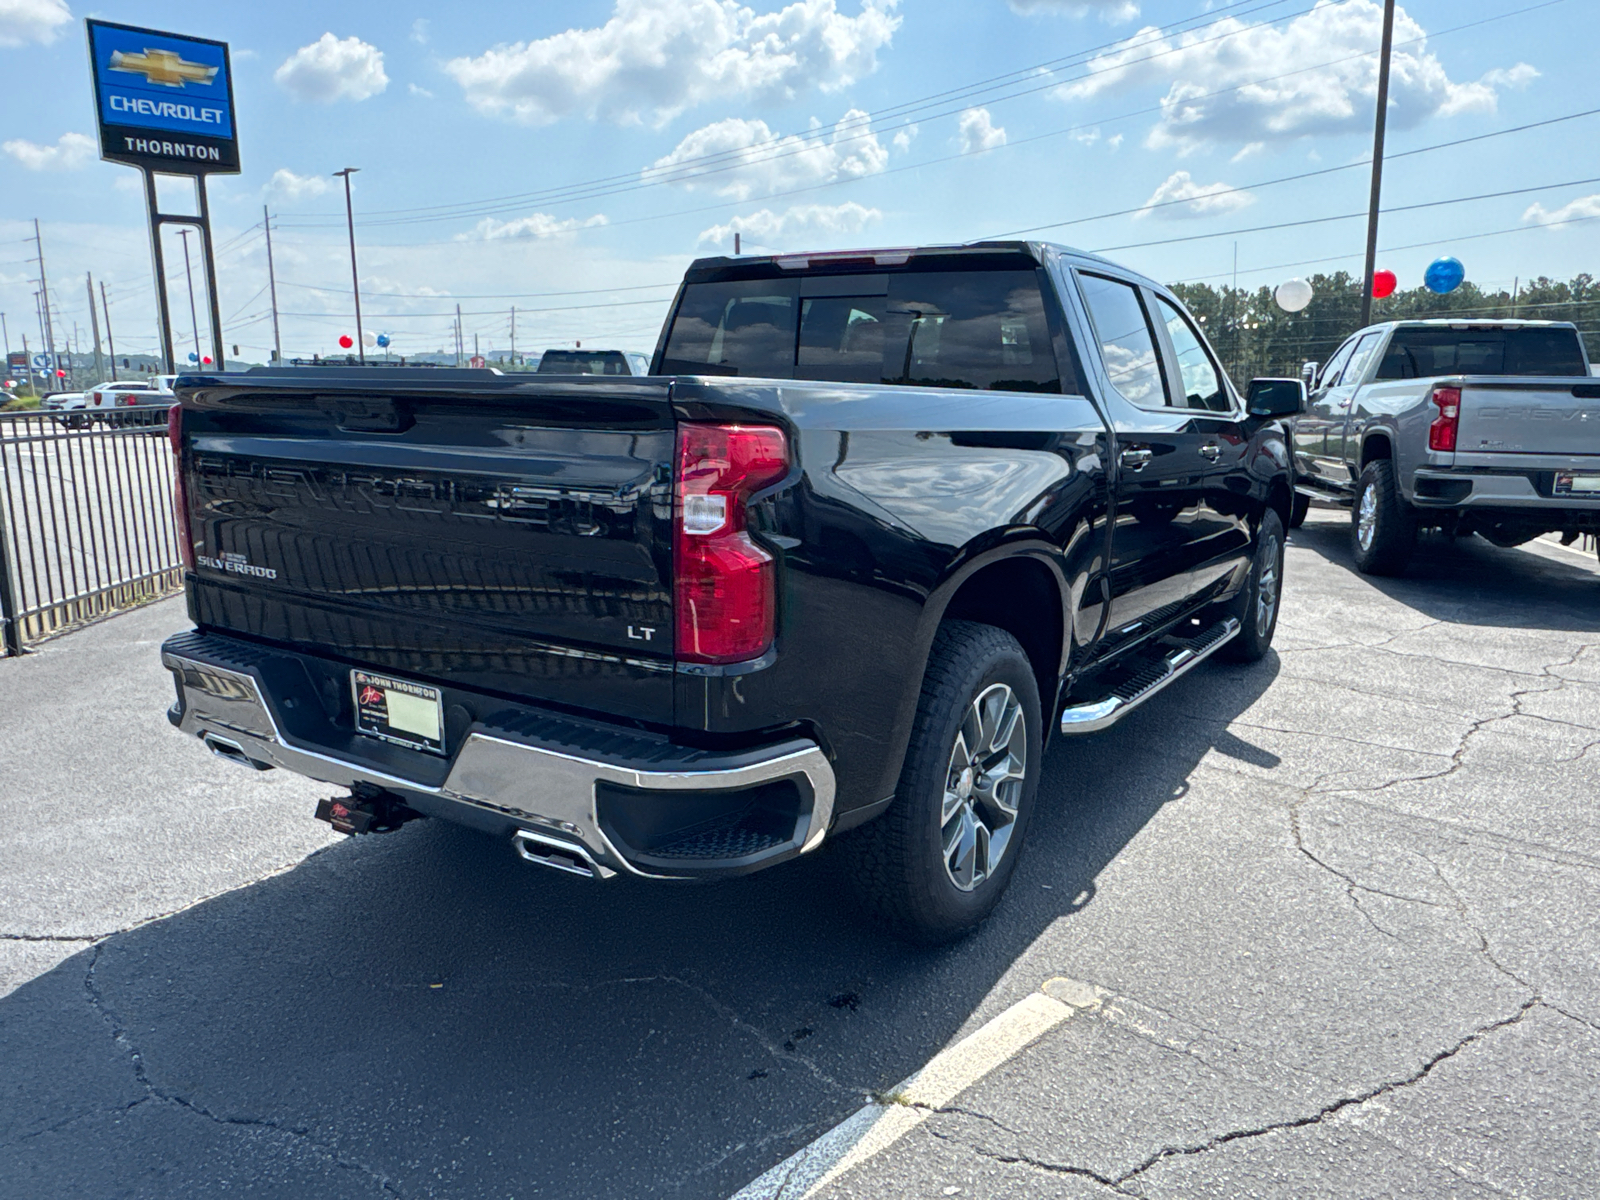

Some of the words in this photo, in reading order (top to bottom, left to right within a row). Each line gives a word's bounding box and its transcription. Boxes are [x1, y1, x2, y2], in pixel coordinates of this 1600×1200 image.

[109, 95, 223, 124] CHEVROLET
[124, 136, 220, 160] THORNTON
[197, 555, 277, 579] SILVERADO
[627, 625, 656, 641] LT
[370, 676, 391, 688] JOHN
[392, 681, 435, 699] THORNTON
